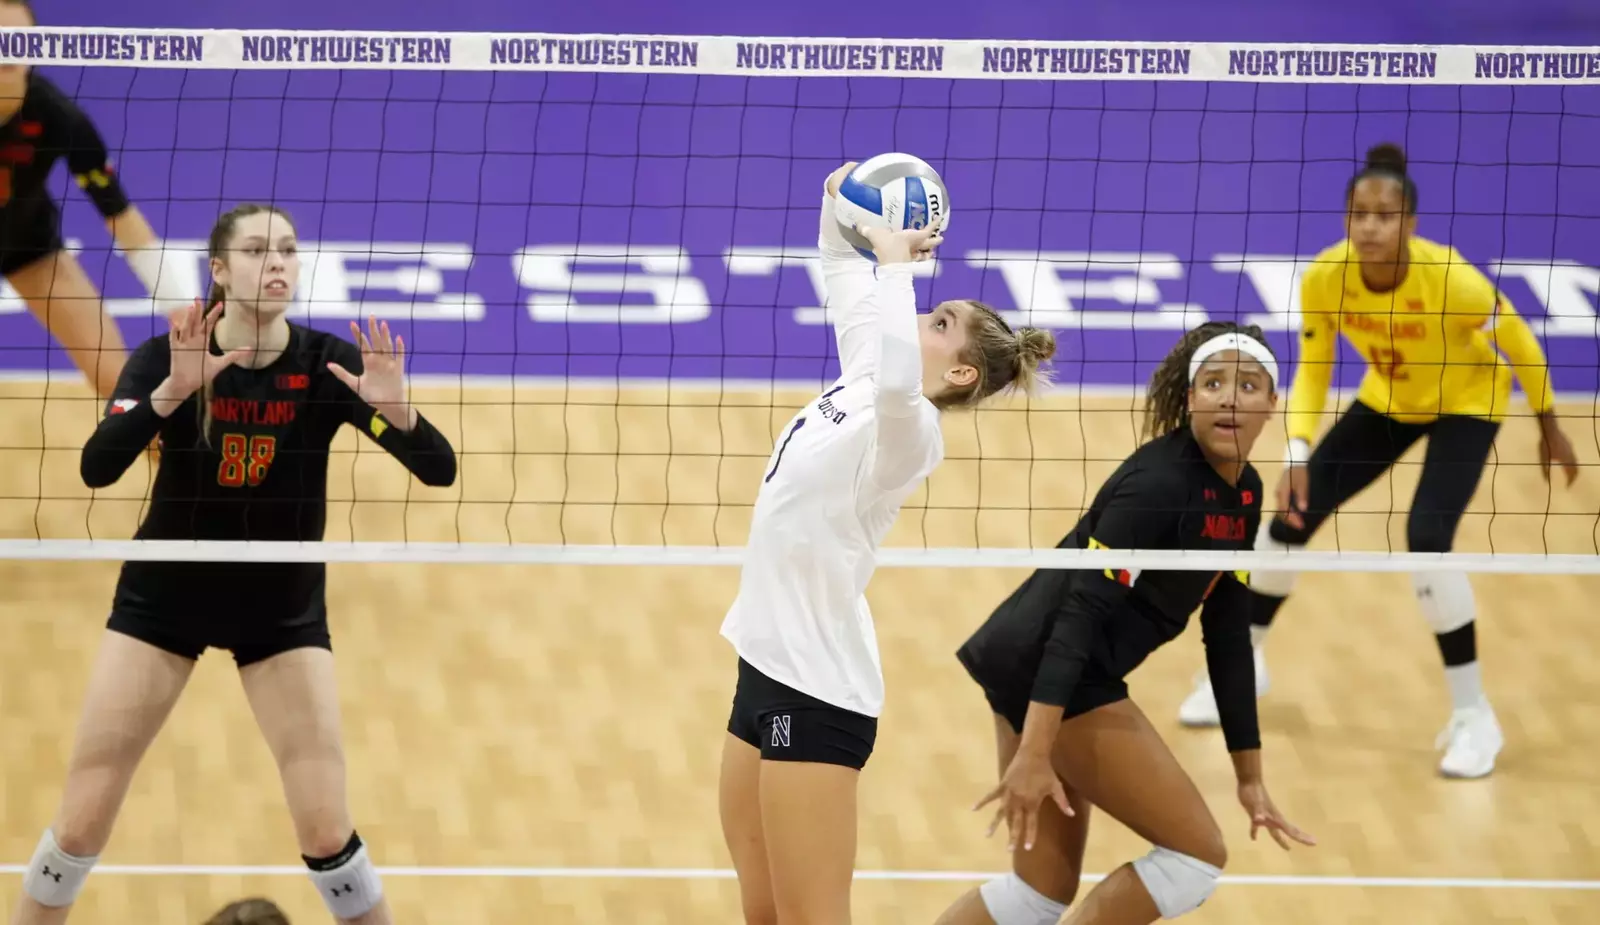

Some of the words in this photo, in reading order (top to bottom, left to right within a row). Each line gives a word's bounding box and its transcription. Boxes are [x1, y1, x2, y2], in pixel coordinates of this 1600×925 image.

[242, 36, 451, 64] NORTHWESTERN
[490, 38, 698, 67] NORTHWESTERN
[736, 43, 944, 71] NORTHWESTERN
[982, 47, 1191, 75] NORTHWESTERN
[1228, 50, 1437, 78] NORTHWESTERN
[1475, 53, 1600, 78] NORTHWE
[217, 433, 276, 487] 88
[771, 714, 791, 747] N
